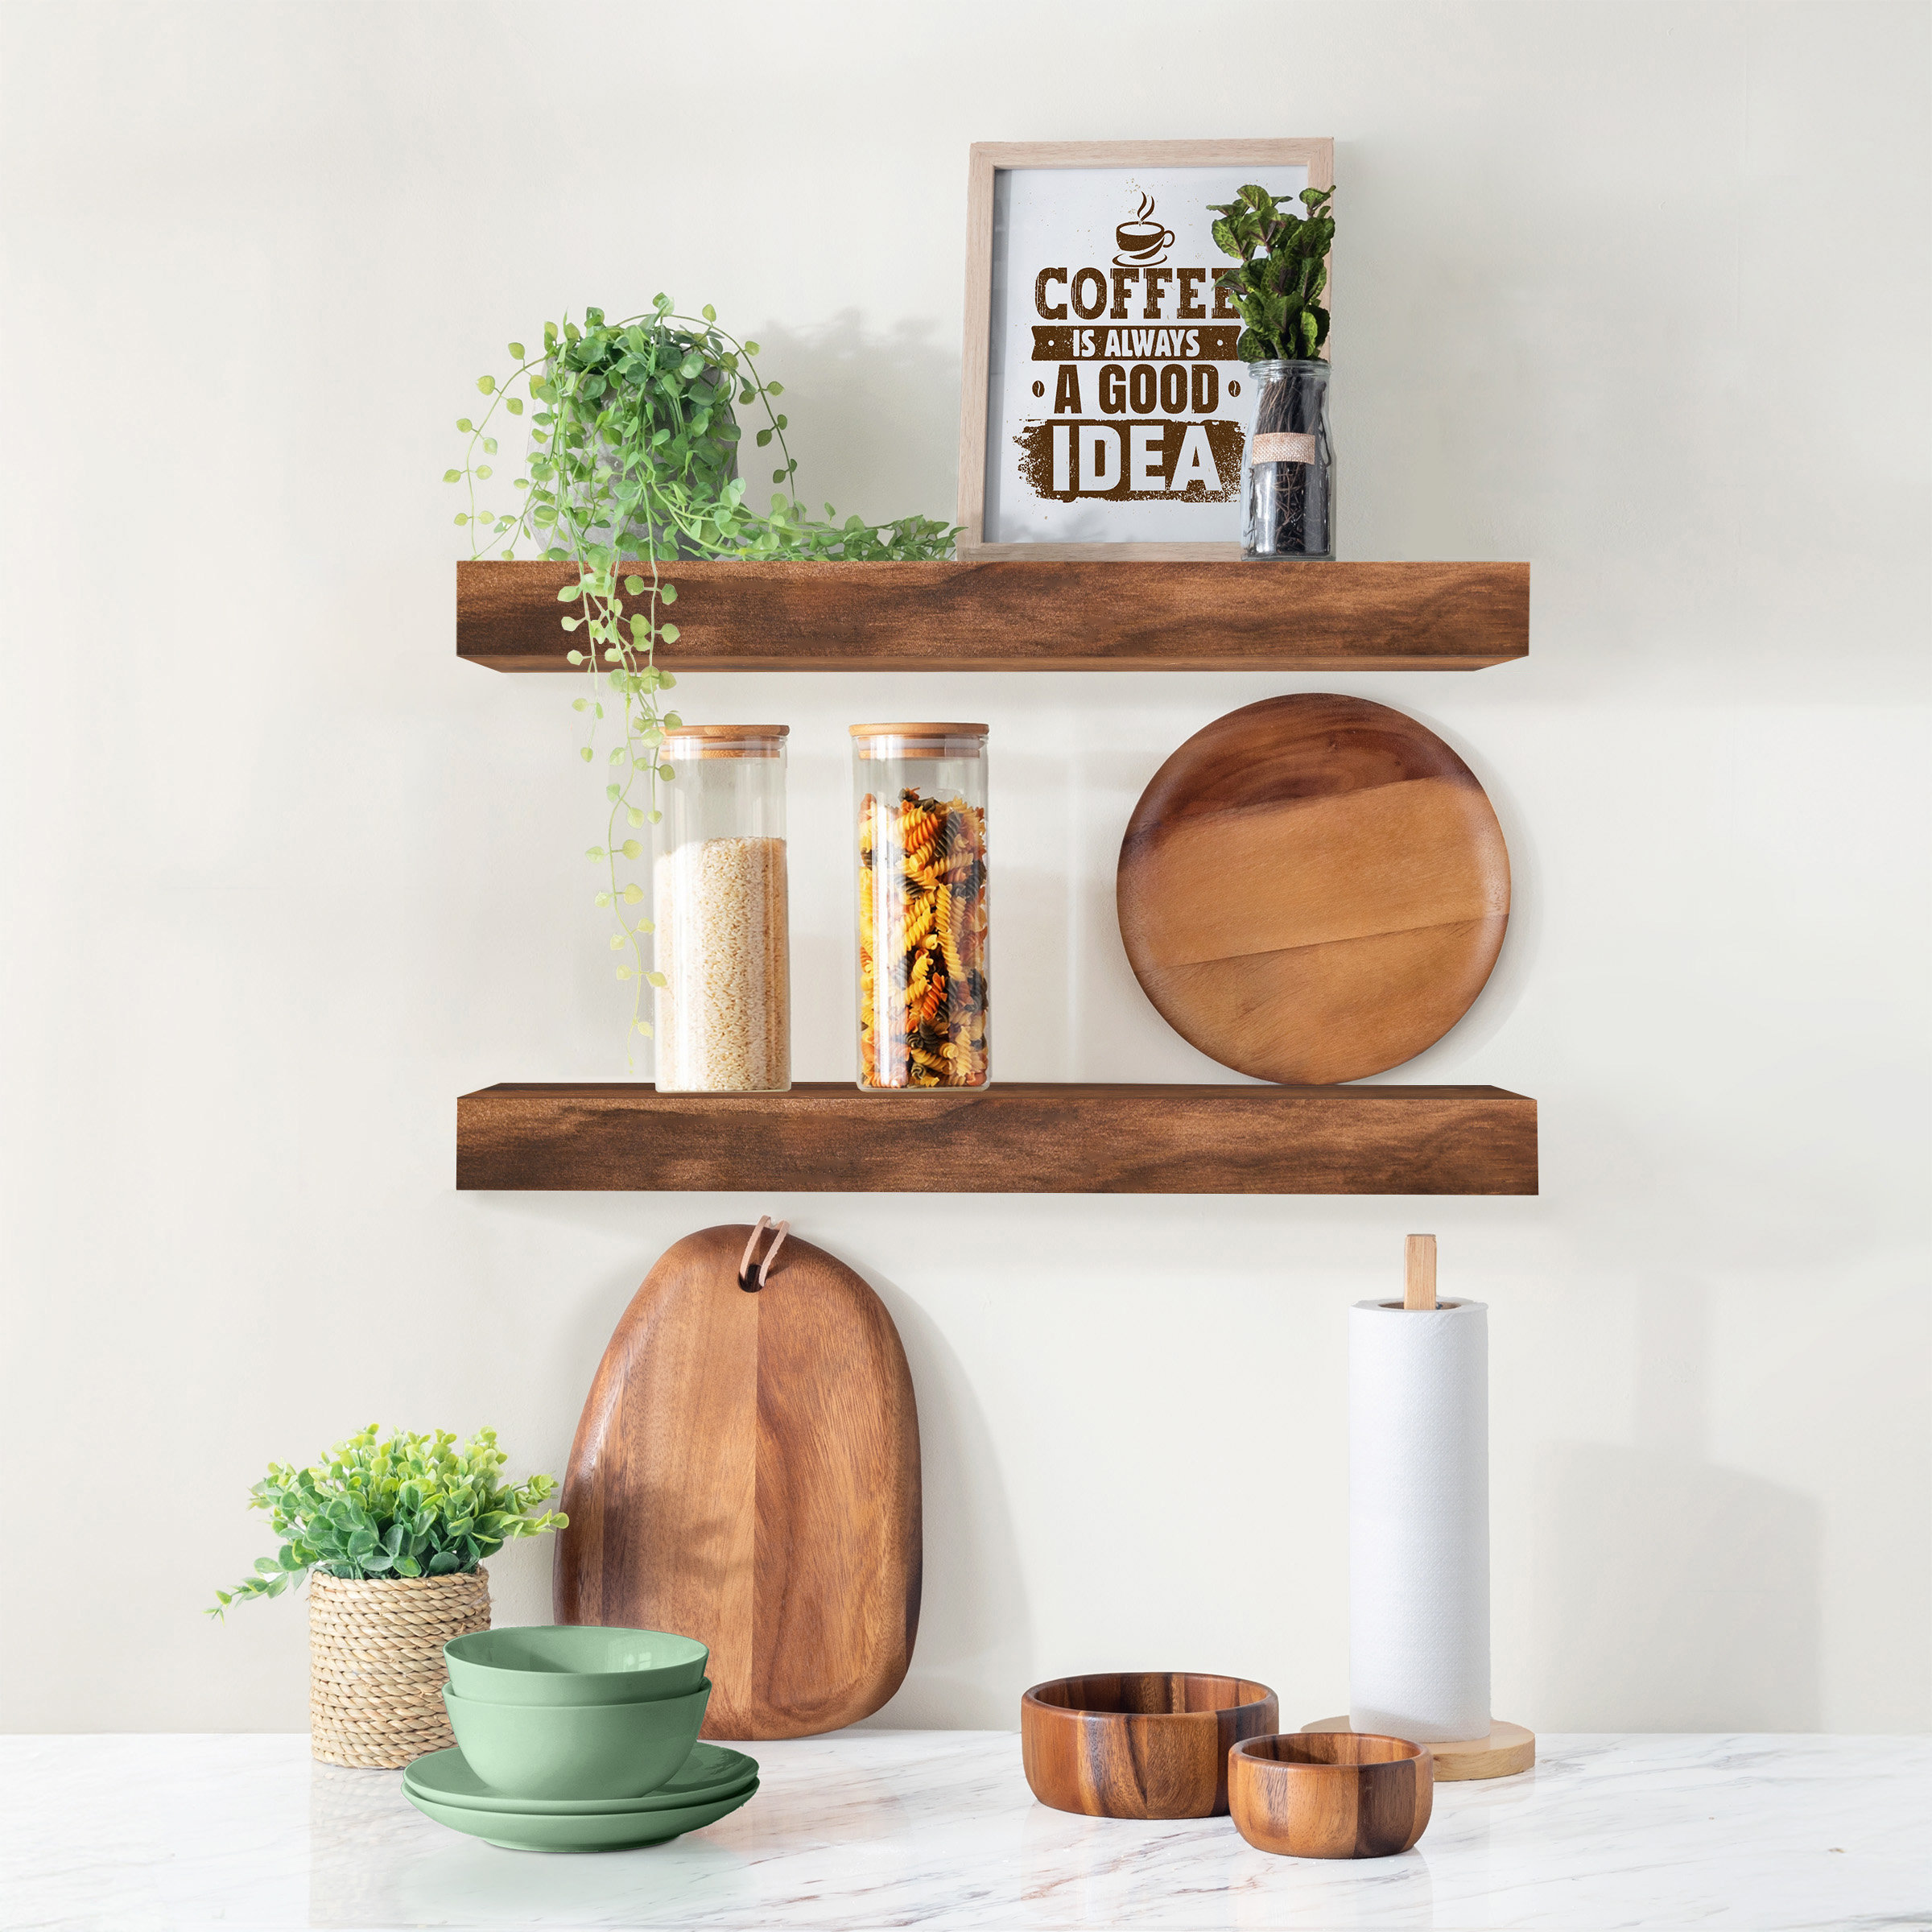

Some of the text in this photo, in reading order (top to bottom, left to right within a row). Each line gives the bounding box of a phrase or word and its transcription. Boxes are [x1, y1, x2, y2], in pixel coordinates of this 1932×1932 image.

[1035, 266, 1241, 320] COFFEE
[1072, 329, 1200, 357] IS ALWAYS
[1053, 364, 1220, 415] A GOOD
[1052, 424, 1224, 492] IDEA
